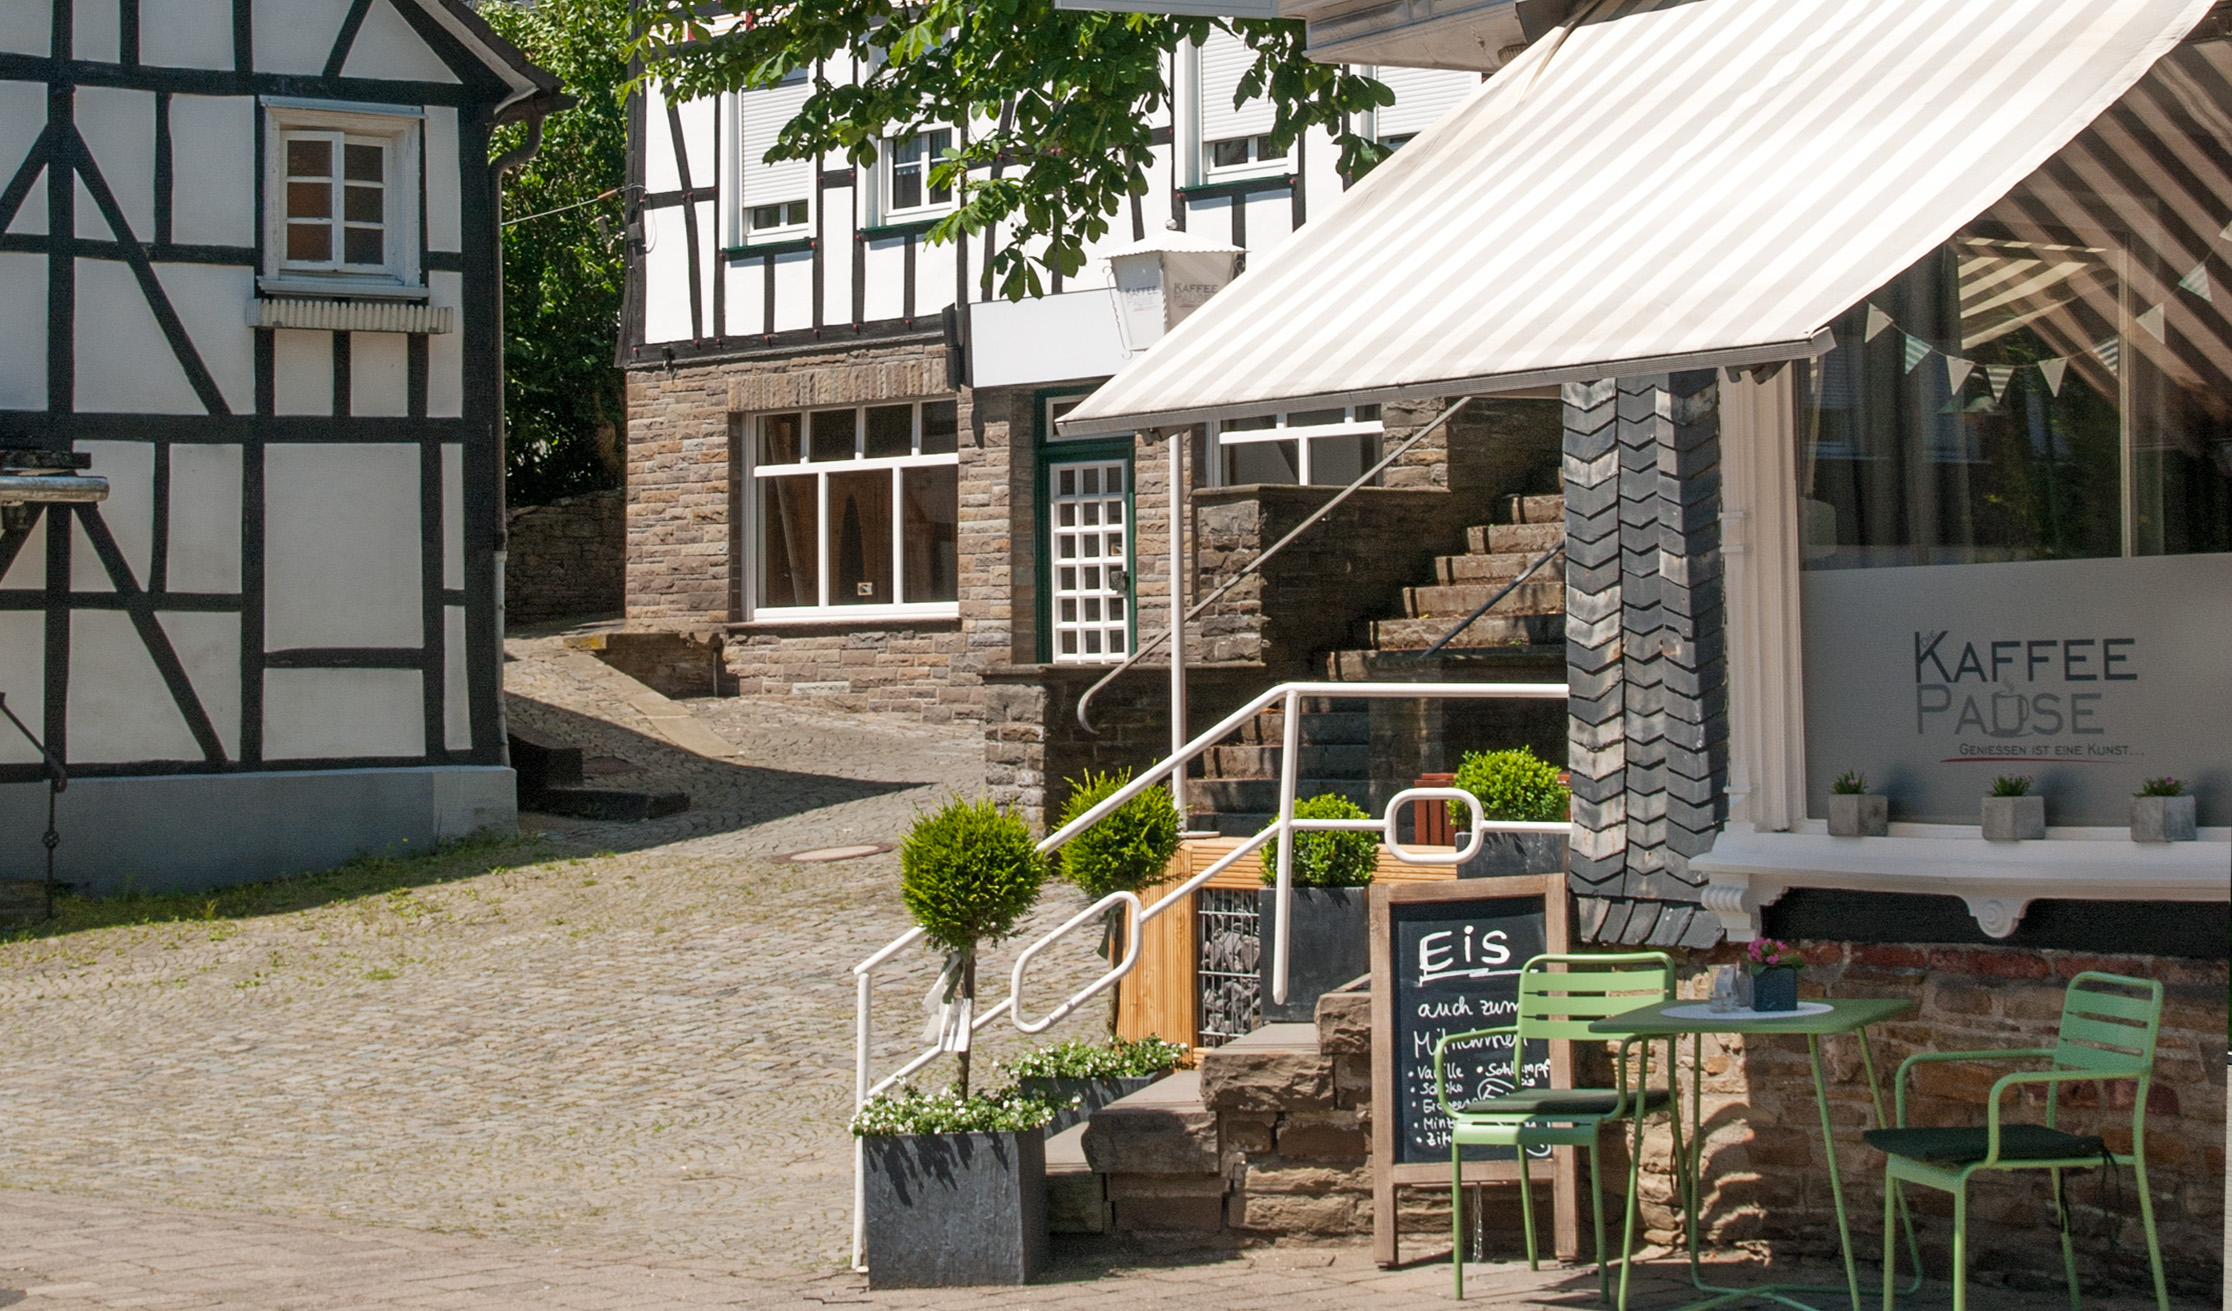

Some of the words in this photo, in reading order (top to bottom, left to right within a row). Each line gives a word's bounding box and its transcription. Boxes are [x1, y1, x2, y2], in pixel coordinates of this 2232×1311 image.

[1174, 282, 1218, 294] KAFFEE
[1914, 630, 2138, 683] KAFFEE
[1916, 683, 2104, 738] PAUSE
[1959, 742, 2027, 756] GENIESSEN
[1419, 925, 1511, 971] Eis
[1418, 996, 1473, 1018] auch
[1480, 1000, 1519, 1015] zum
